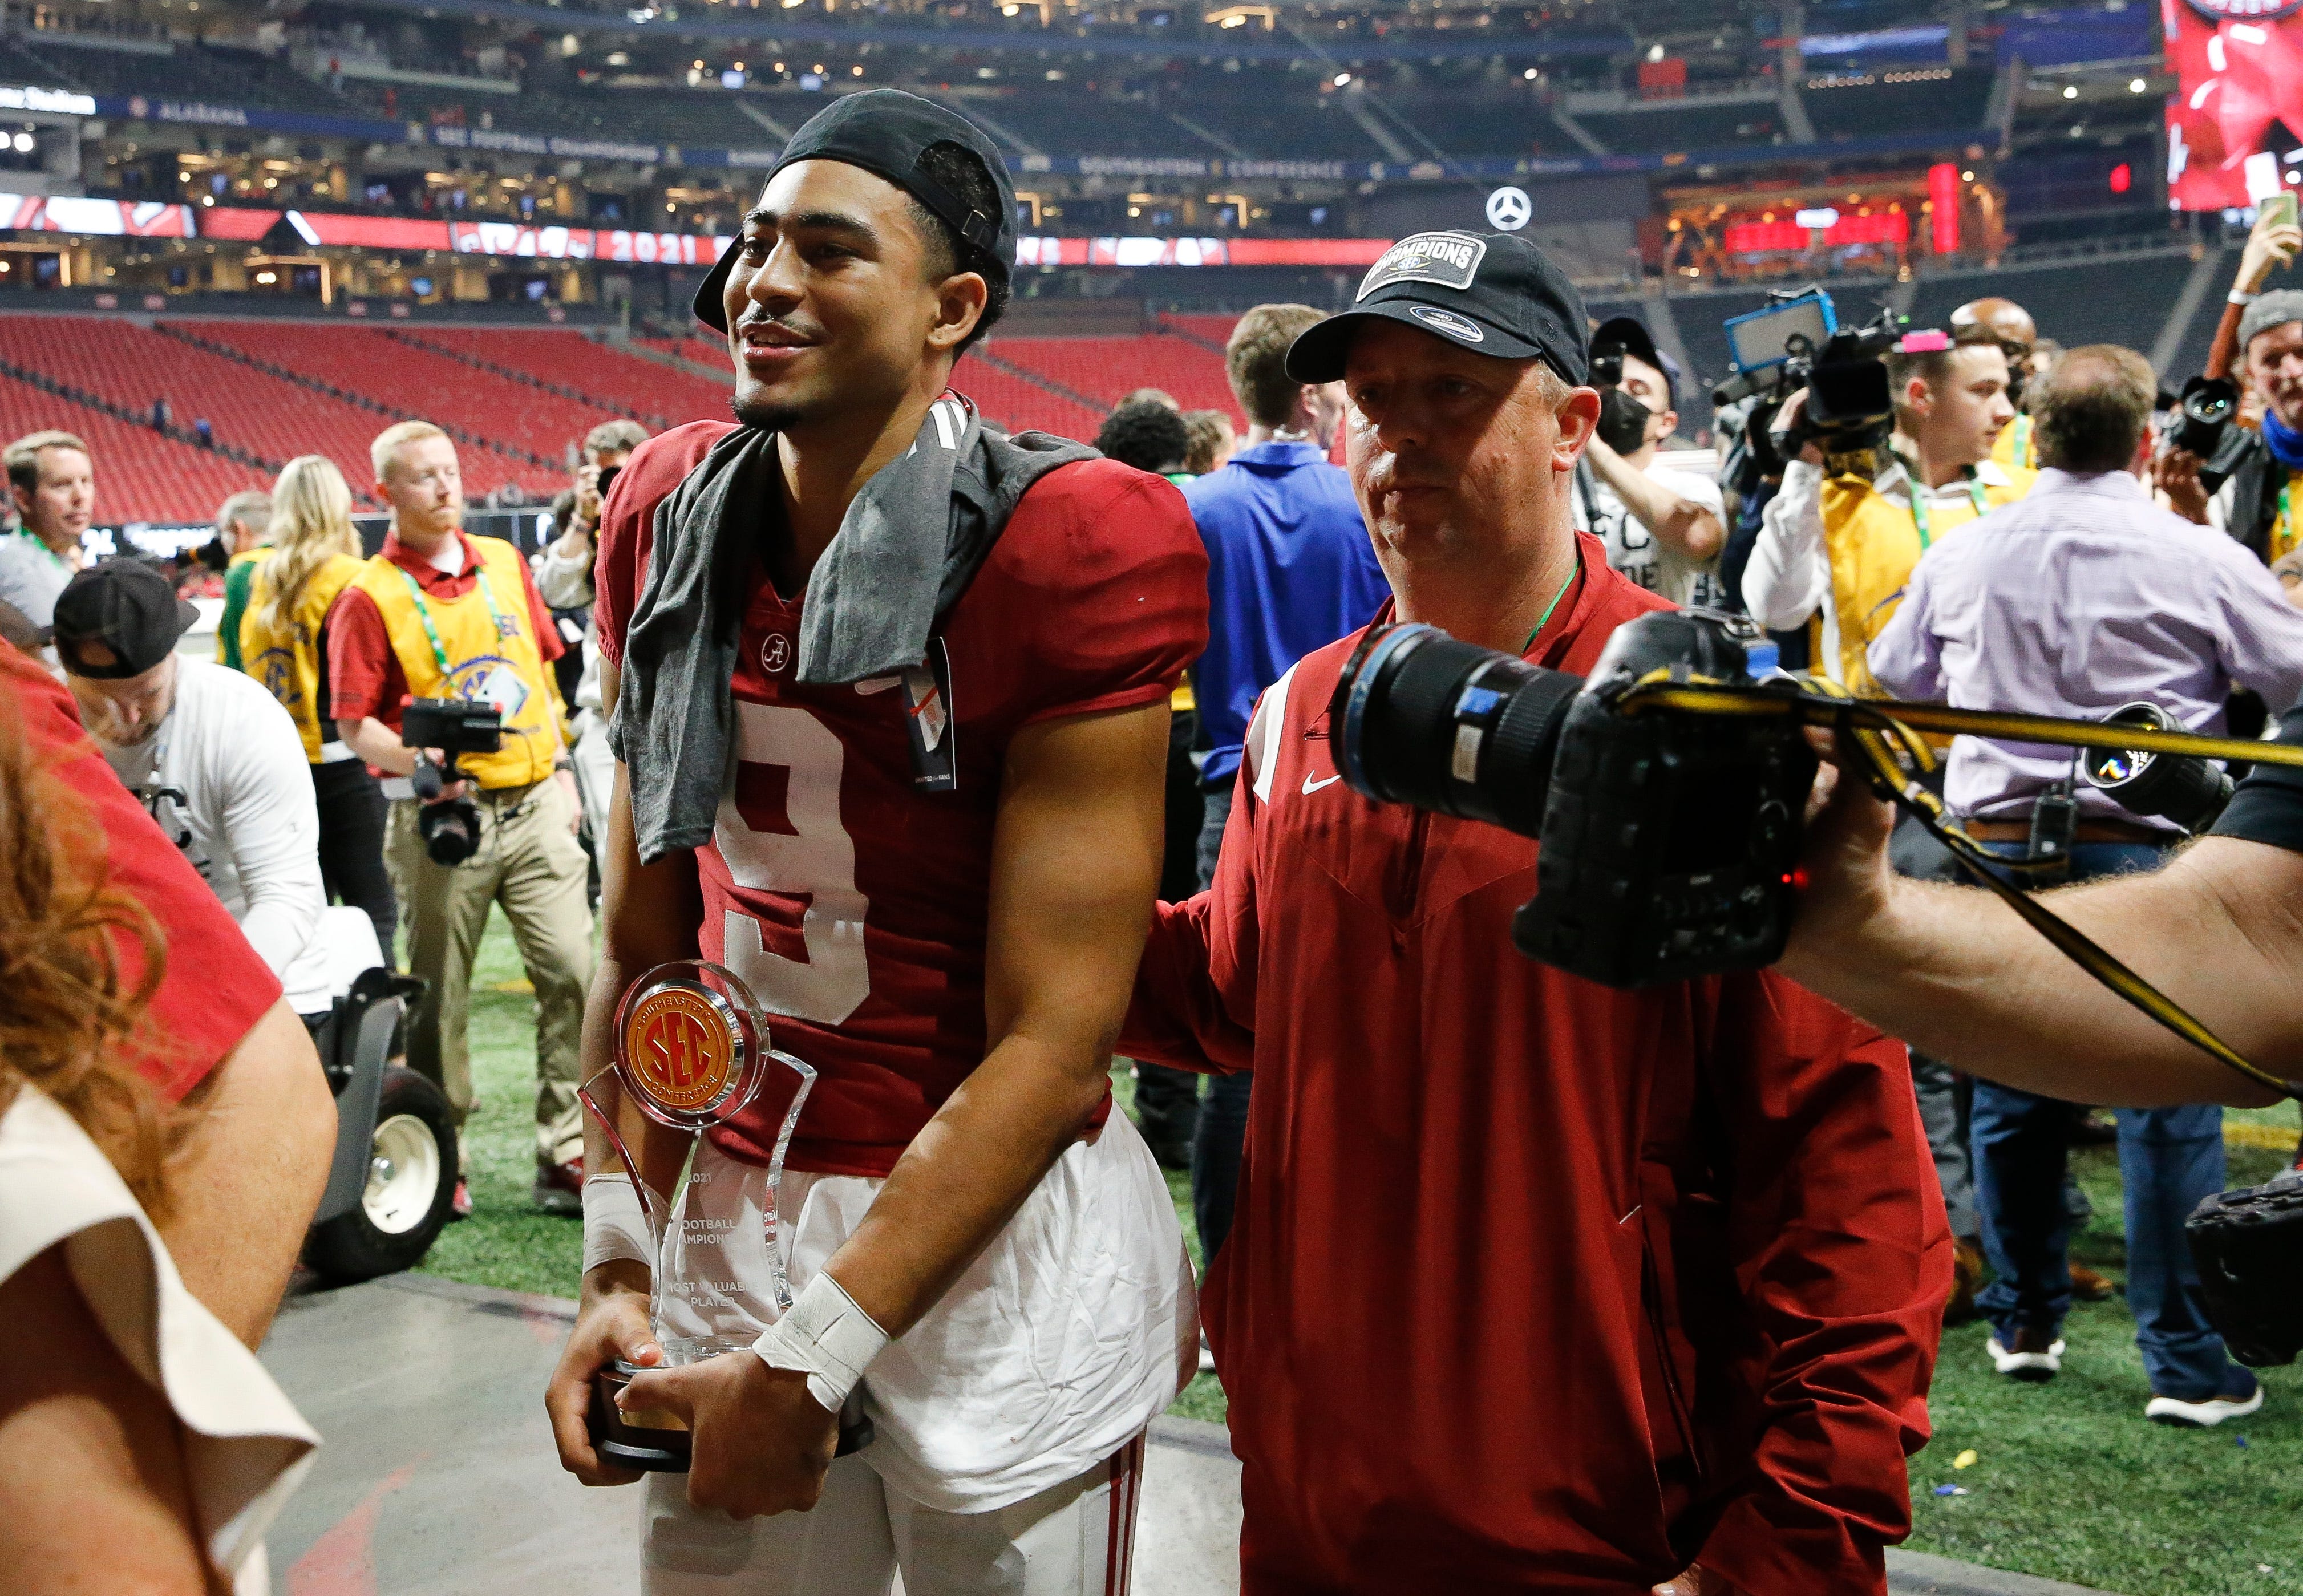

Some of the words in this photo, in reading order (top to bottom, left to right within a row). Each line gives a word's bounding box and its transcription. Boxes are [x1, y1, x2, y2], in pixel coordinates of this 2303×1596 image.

[612, 230, 697, 264] 2021
[1428, 236, 1476, 248] CHAMPIONSHIP
[1367, 241, 1474, 282] CHAMPIONS
[1399, 257, 1420, 270] SEC
[714, 700, 871, 1026] 9
[638, 996, 711, 1027] SOUTHEASTERN
[645, 1010, 713, 1087] SEC
[651, 1074, 717, 1101] CONFERENCE
[683, 1218, 736, 1229] OOTBALL
